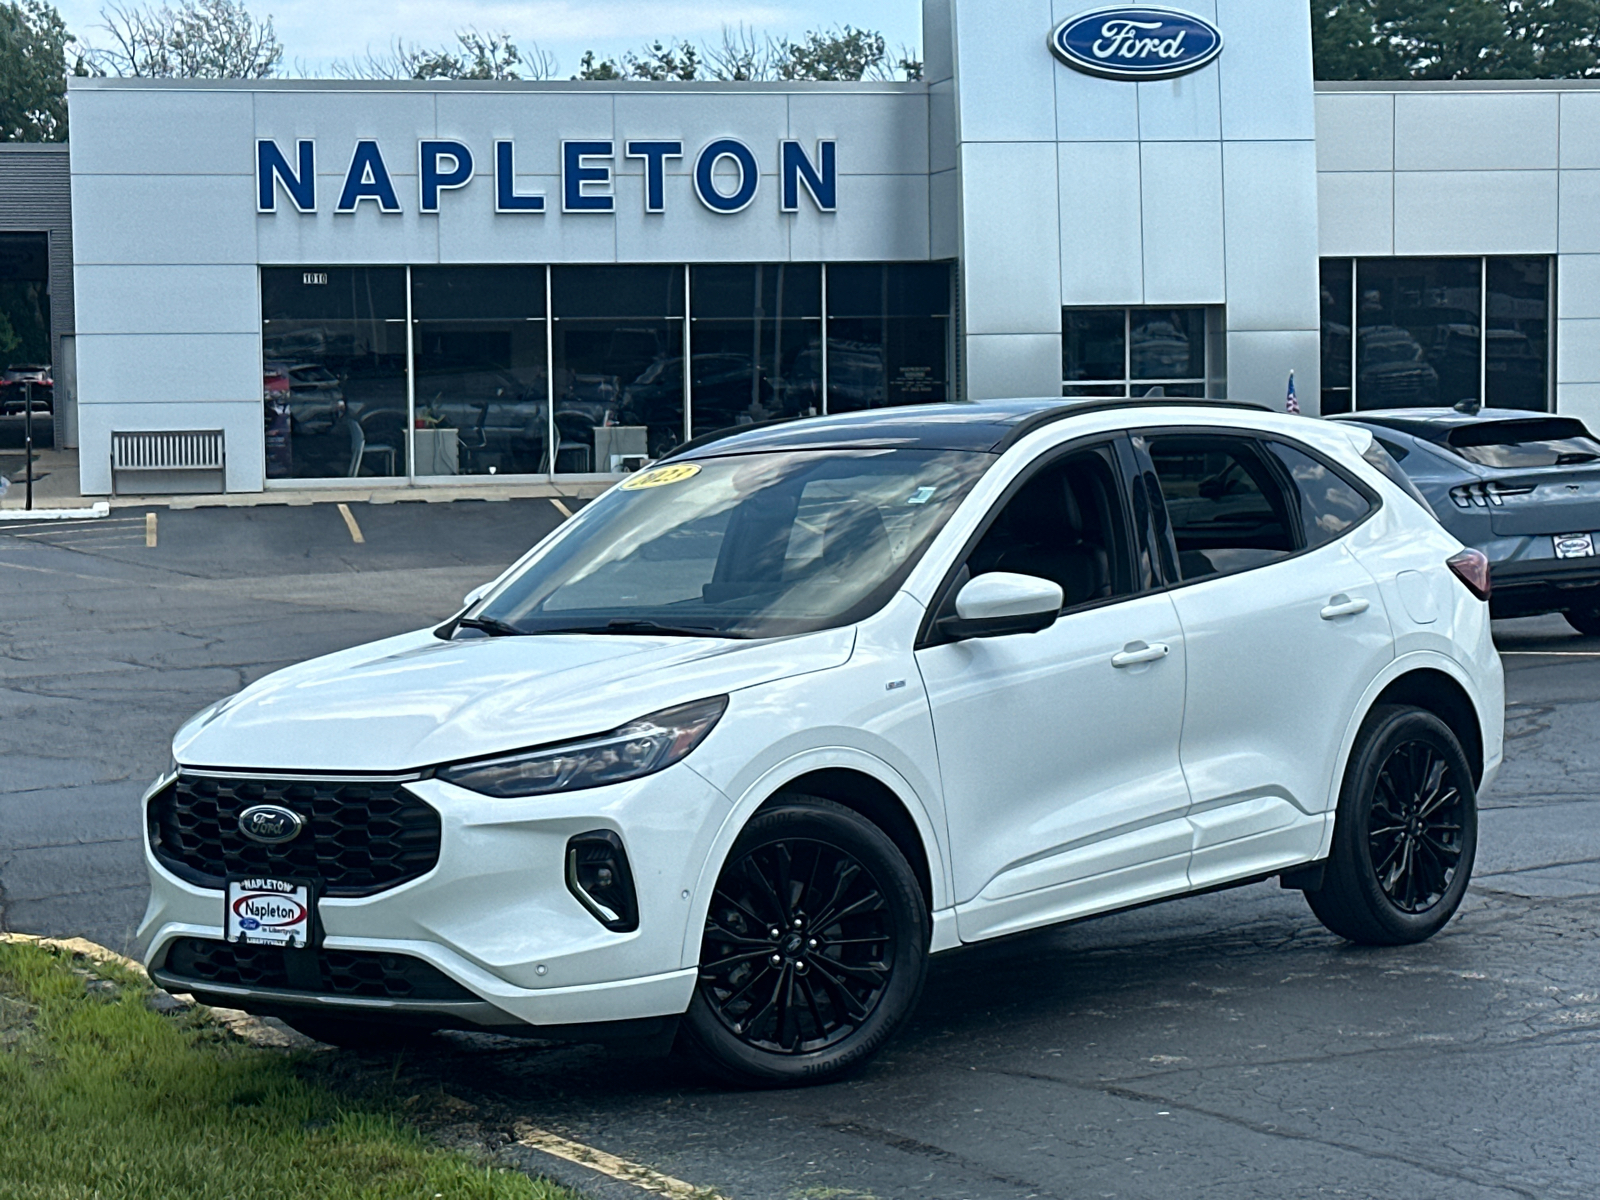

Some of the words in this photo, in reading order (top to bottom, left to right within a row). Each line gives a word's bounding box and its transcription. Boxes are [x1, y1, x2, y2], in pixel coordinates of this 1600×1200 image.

[1092, 19, 1186, 59] Ford
[254, 137, 837, 215] NAPLETON
[303, 272, 328, 284] 1010
[251, 812, 285, 834] Ford
[245, 901, 294, 920] Napleton
